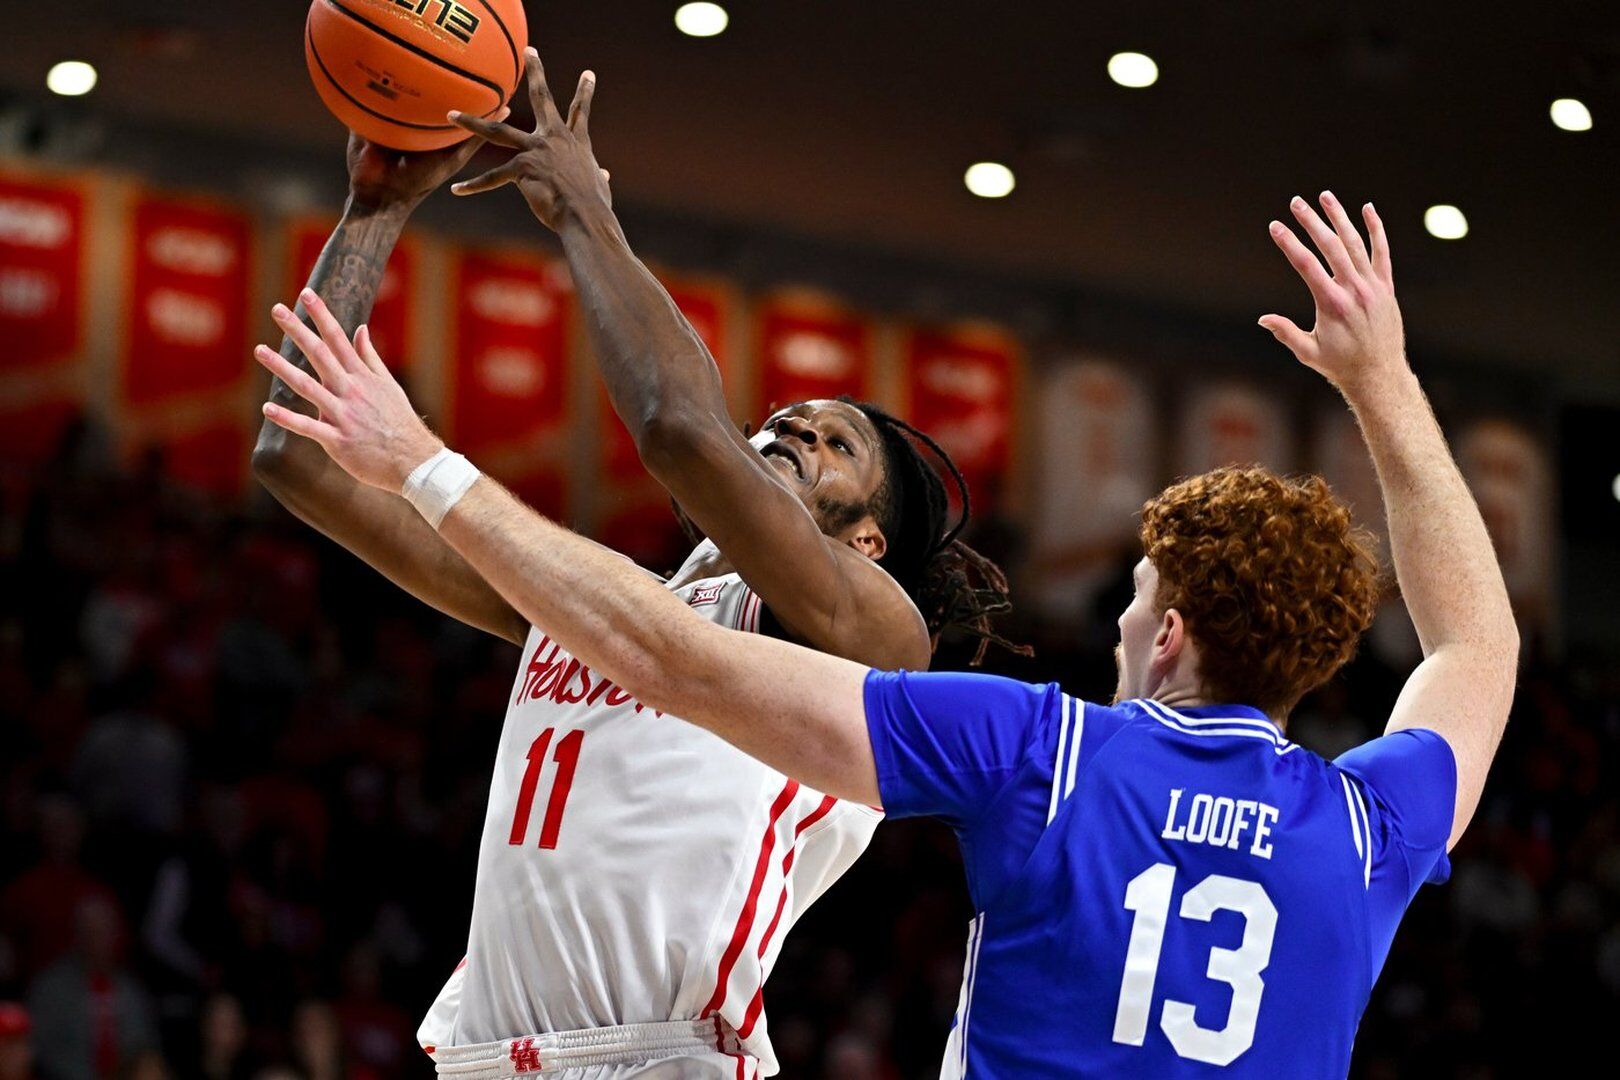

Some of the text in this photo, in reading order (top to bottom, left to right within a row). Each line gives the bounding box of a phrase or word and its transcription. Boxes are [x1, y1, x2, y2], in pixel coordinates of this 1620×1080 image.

[516, 635, 665, 718] Hous
[509, 727, 585, 850] 11
[1161, 788, 1279, 860] LOOFE
[1112, 862, 1279, 1067] 13
